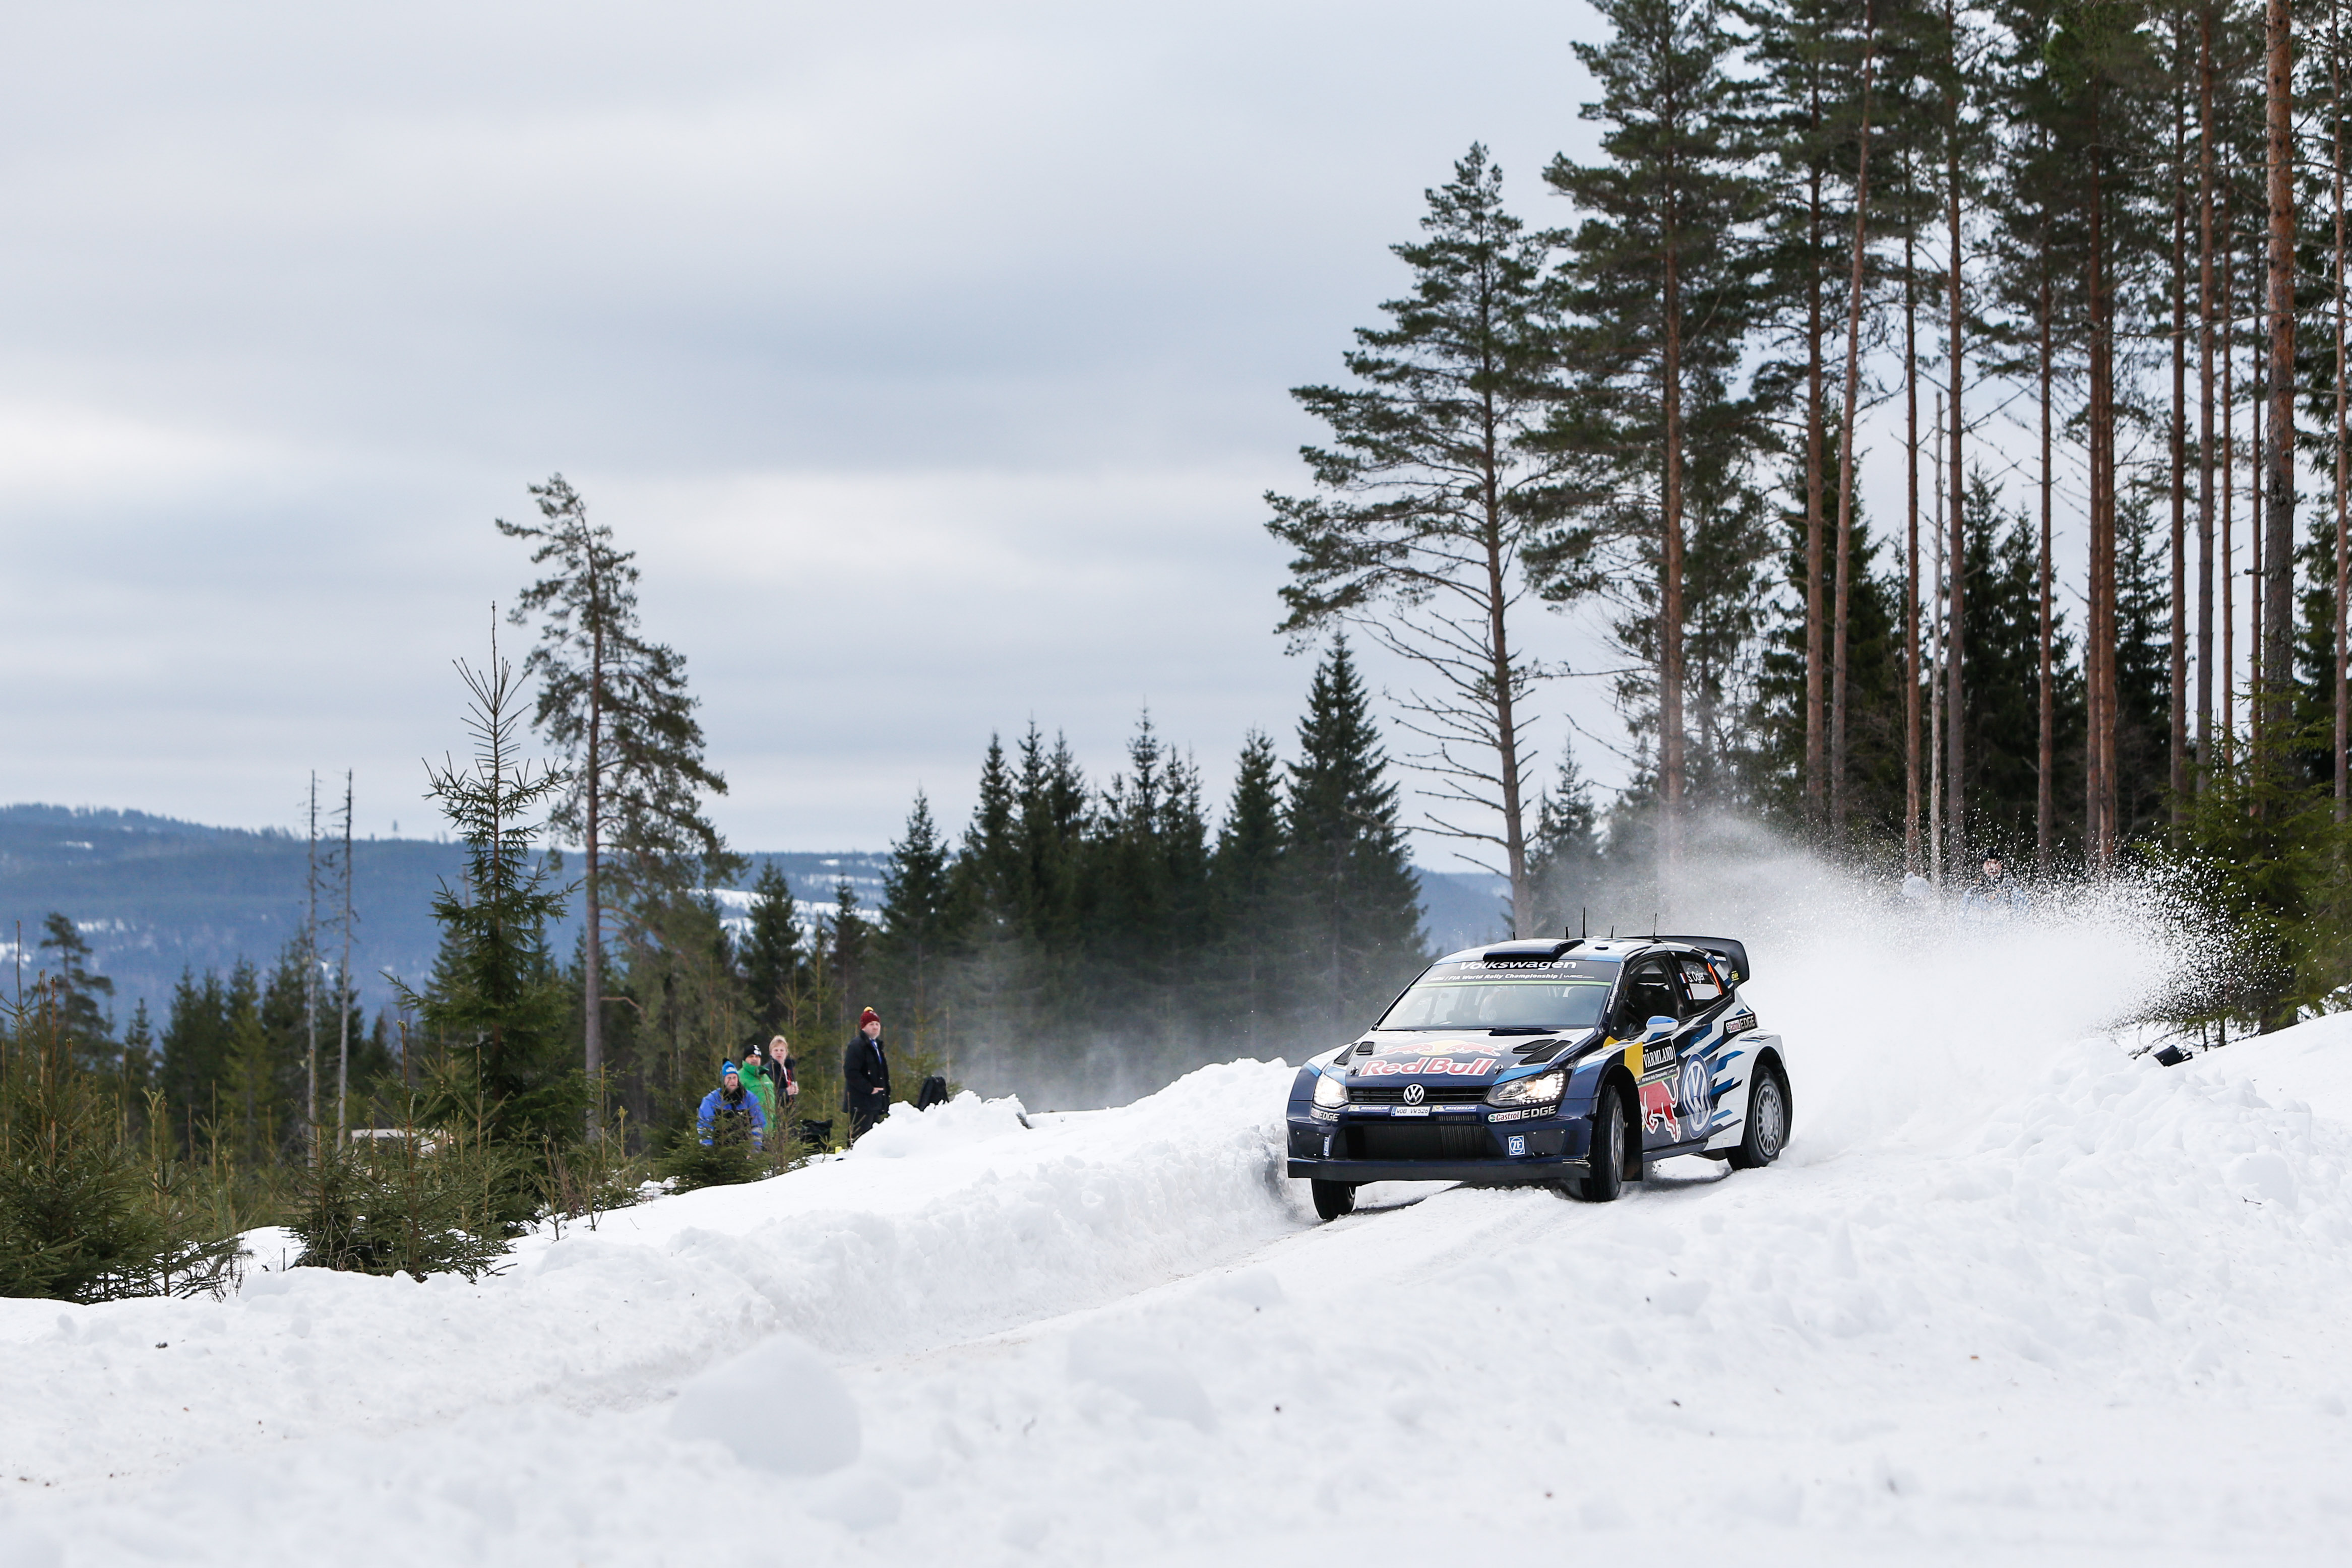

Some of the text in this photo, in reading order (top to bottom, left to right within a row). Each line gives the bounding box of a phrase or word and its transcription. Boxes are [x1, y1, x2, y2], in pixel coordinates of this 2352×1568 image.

[1460, 961, 1576, 971] Volkswagen
[1691, 971, 1705, 984] Ogier
[1708, 963, 1722, 995] 1
[1739, 1016, 1755, 1030] EDGE
[1643, 1046, 1674, 1068] VÄRMLAND
[1360, 1057, 1496, 1076] Red Bull
[1319, 1110, 1340, 1122] EDGE
[1496, 1105, 1557, 1121] Castrol EDGE
[1512, 1140, 1522, 1151] ZF
